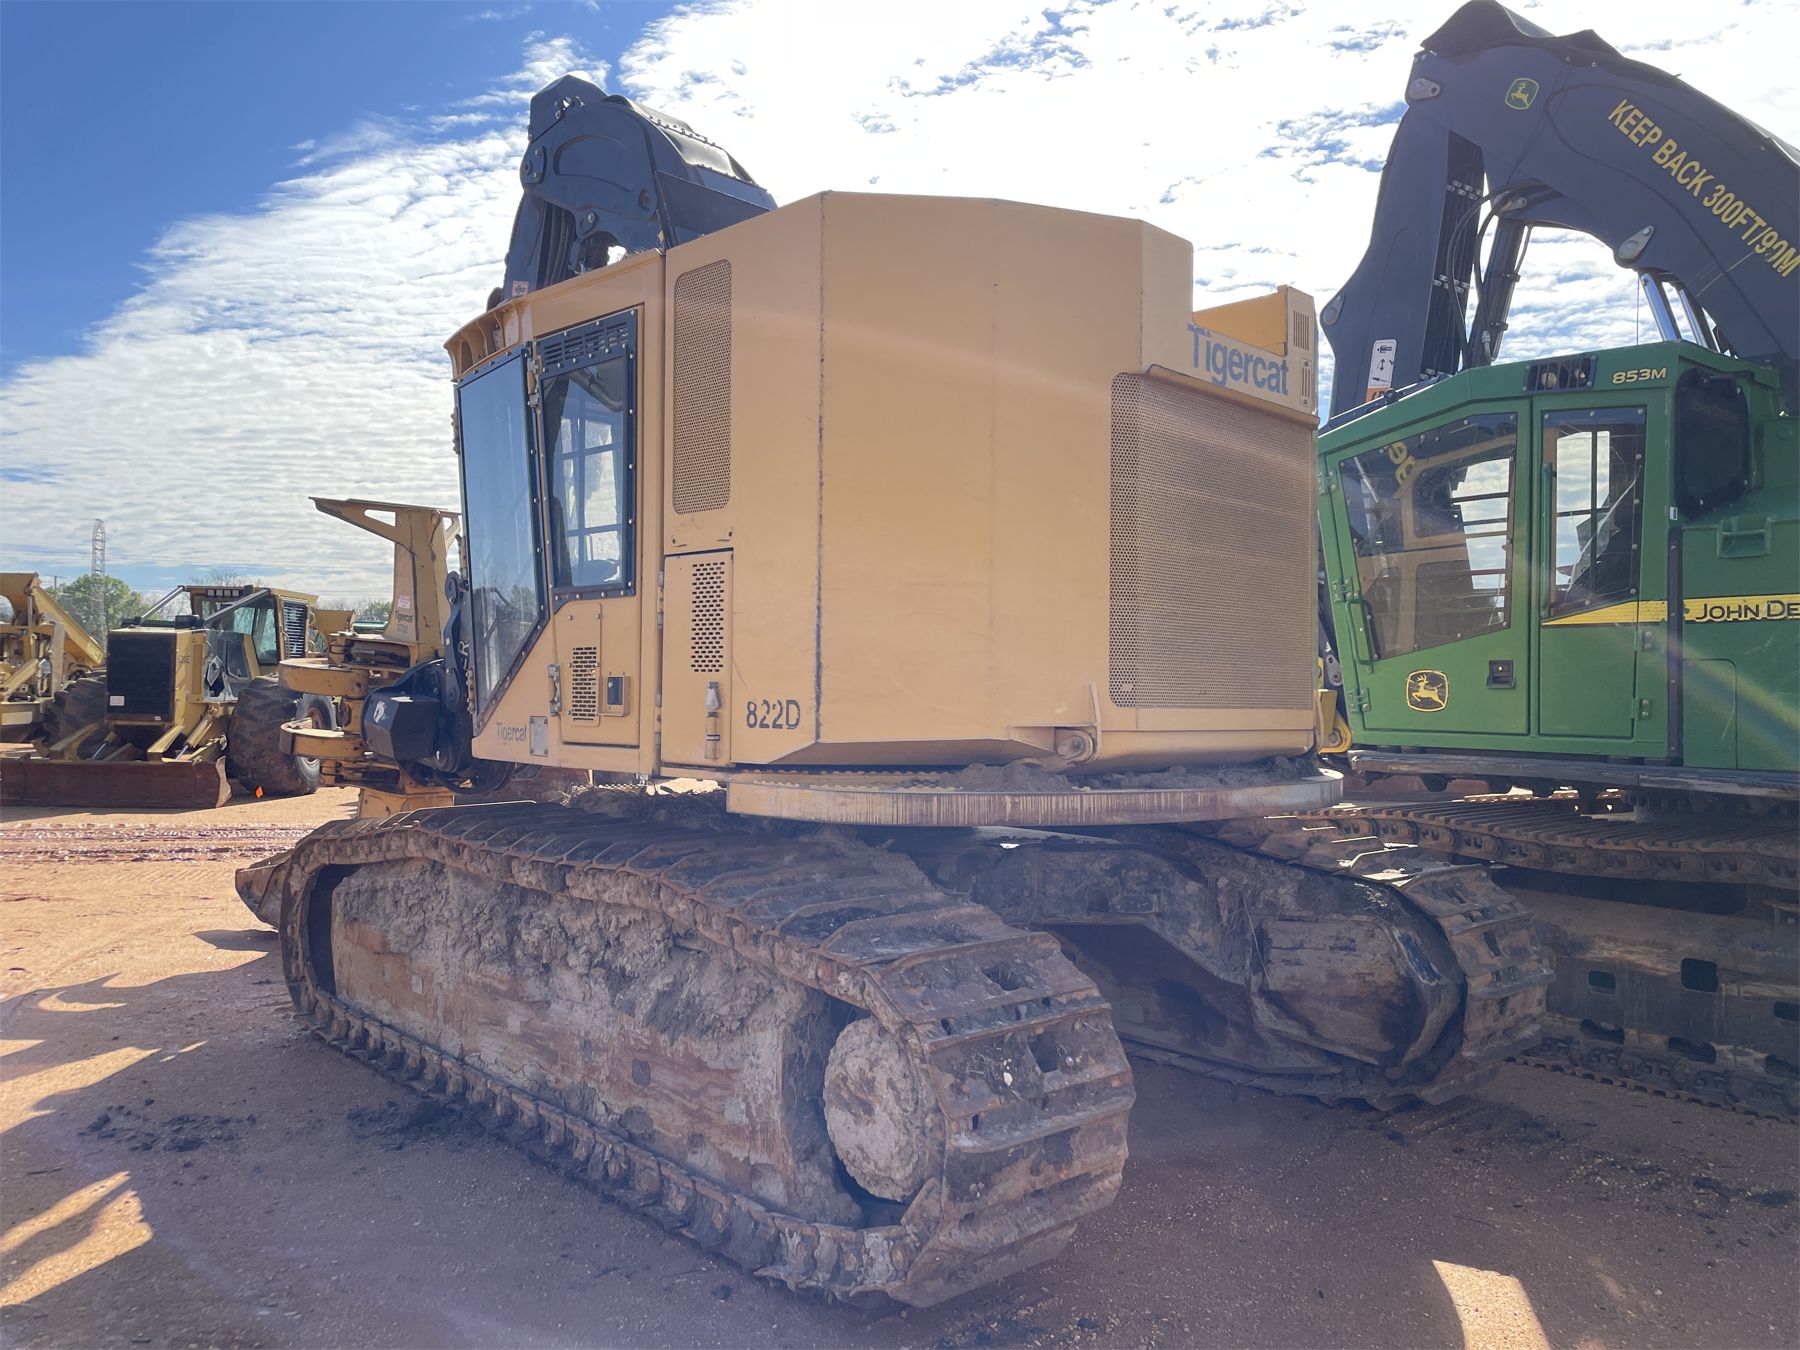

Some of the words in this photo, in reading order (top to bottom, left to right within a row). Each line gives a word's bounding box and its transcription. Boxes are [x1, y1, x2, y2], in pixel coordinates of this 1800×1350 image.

[1608, 99, 1663, 147] KEEP
[1651, 138, 1714, 197] BACK
[1187, 323, 1289, 396] Tigercat
[1612, 367, 1667, 384] 853M
[1695, 603, 1760, 620] JOHN
[1766, 600, 1800, 618] DE
[746, 699, 801, 729] 822D
